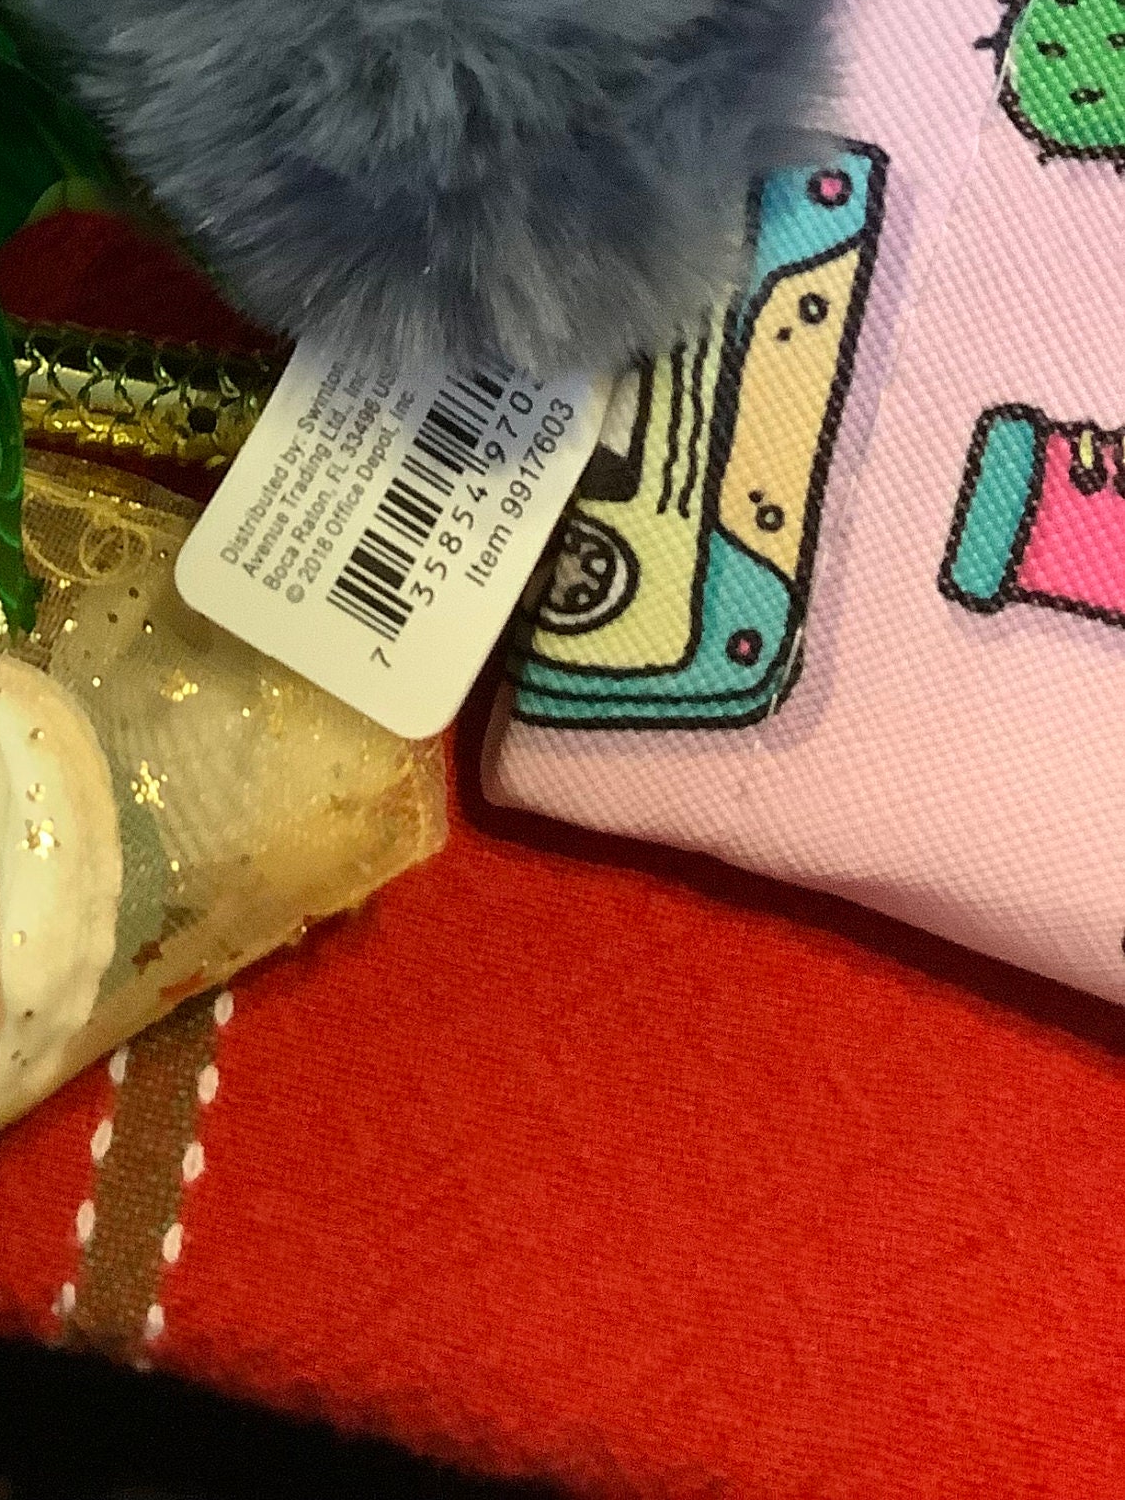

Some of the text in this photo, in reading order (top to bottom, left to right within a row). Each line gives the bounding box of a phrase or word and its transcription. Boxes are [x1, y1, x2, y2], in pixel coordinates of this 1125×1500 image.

[219, 465, 289, 565] Distributed
[278, 434, 308, 466] by:
[241, 511, 289, 580] Avenue
[279, 442, 333, 509] Trading
[261, 545, 300, 591] Boca
[290, 486, 339, 544] Raton,
[325, 461, 350, 485] FL
[297, 535, 335, 585] 2018
[324, 482, 366, 537] Office
[355, 424, 402, 482] Depot,
[369, 379, 546, 669] 7 35854 970
[463, 396, 576, 589] Item 9917603
